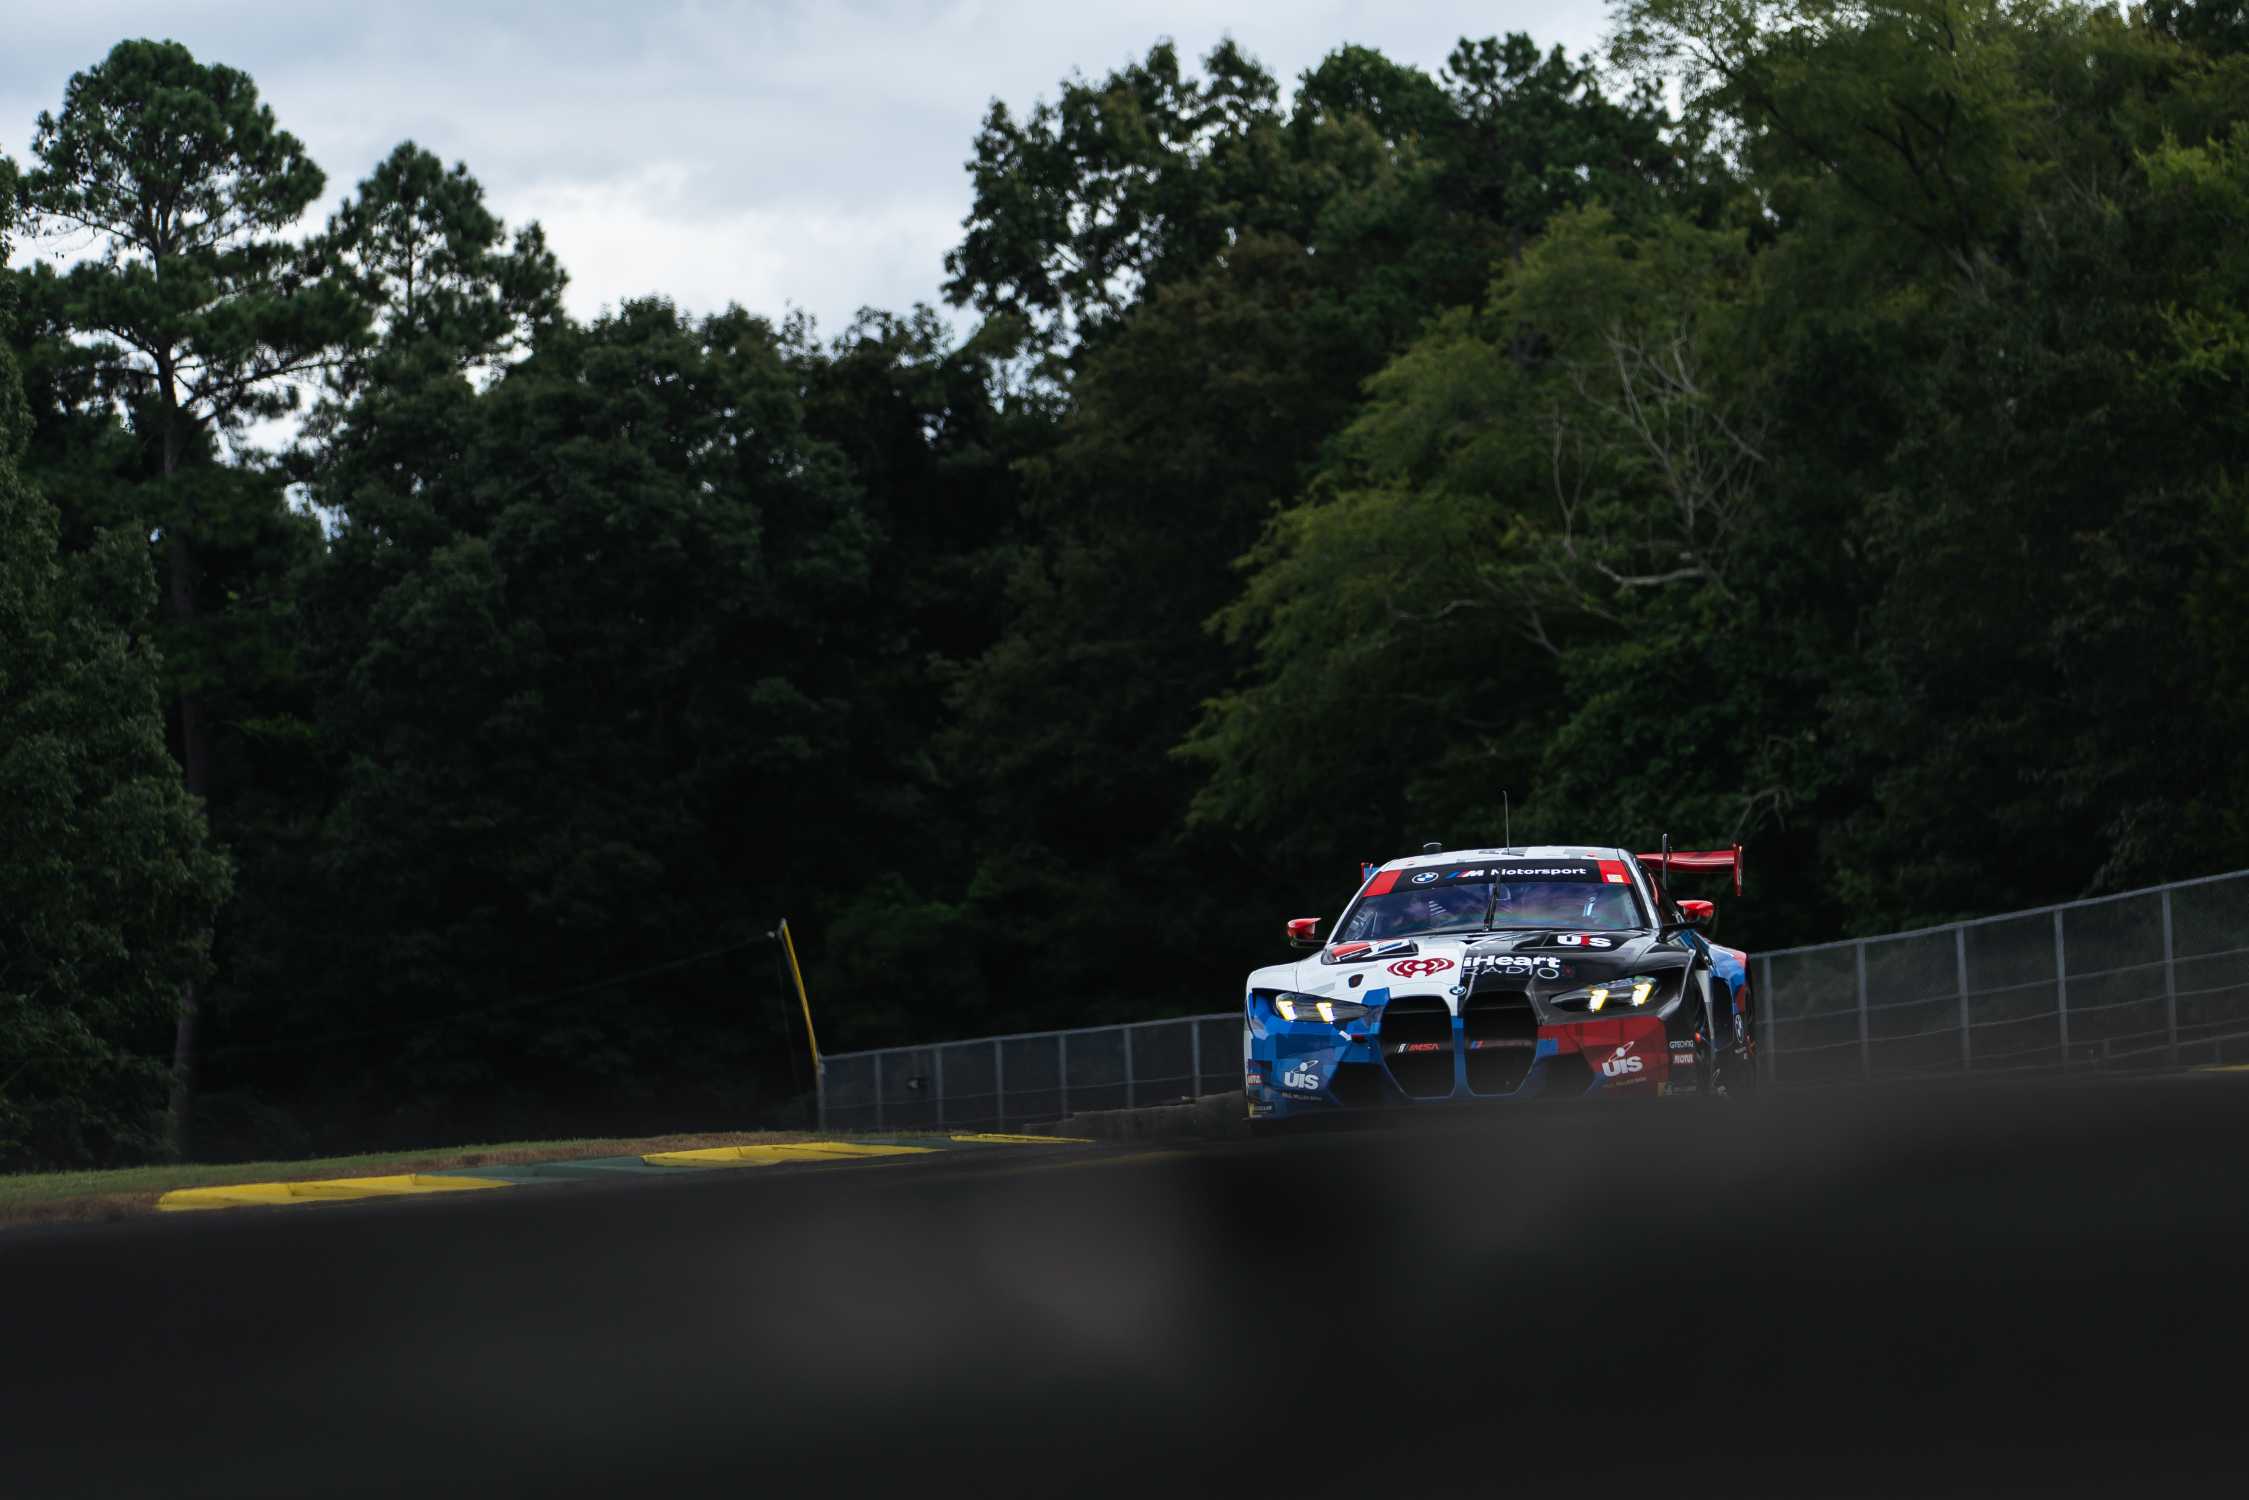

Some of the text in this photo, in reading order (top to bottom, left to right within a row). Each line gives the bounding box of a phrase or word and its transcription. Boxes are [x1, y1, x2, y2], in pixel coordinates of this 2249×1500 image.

[1490, 867, 1587, 877] Motorsport
[1463, 955, 1561, 968] iHeart
[1462, 965, 1560, 979] RADIO
